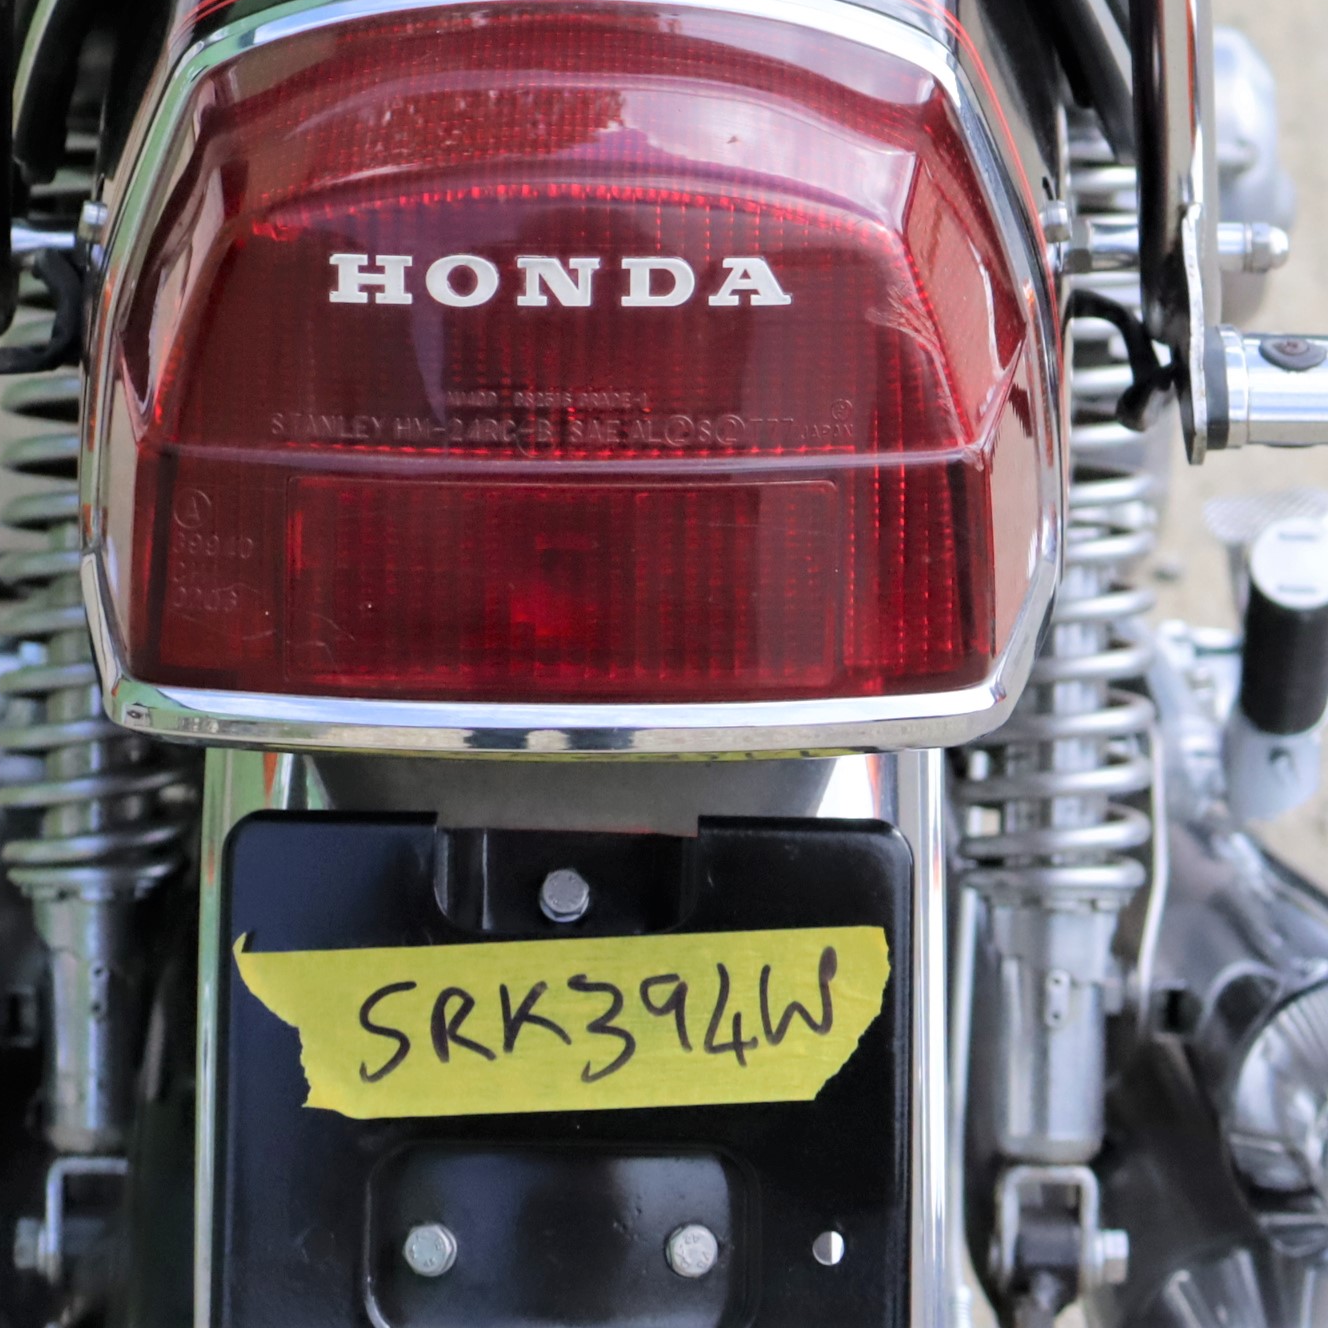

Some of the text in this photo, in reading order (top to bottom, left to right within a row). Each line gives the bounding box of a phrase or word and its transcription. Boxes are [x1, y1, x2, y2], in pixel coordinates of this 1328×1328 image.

[328, 252, 793, 307] HONDA
[271, 412, 384, 440] STANLEY
[570, 419, 623, 444] SAE
[800, 422, 855, 441] JAPAN
[359, 945, 838, 1083] SRK394W
